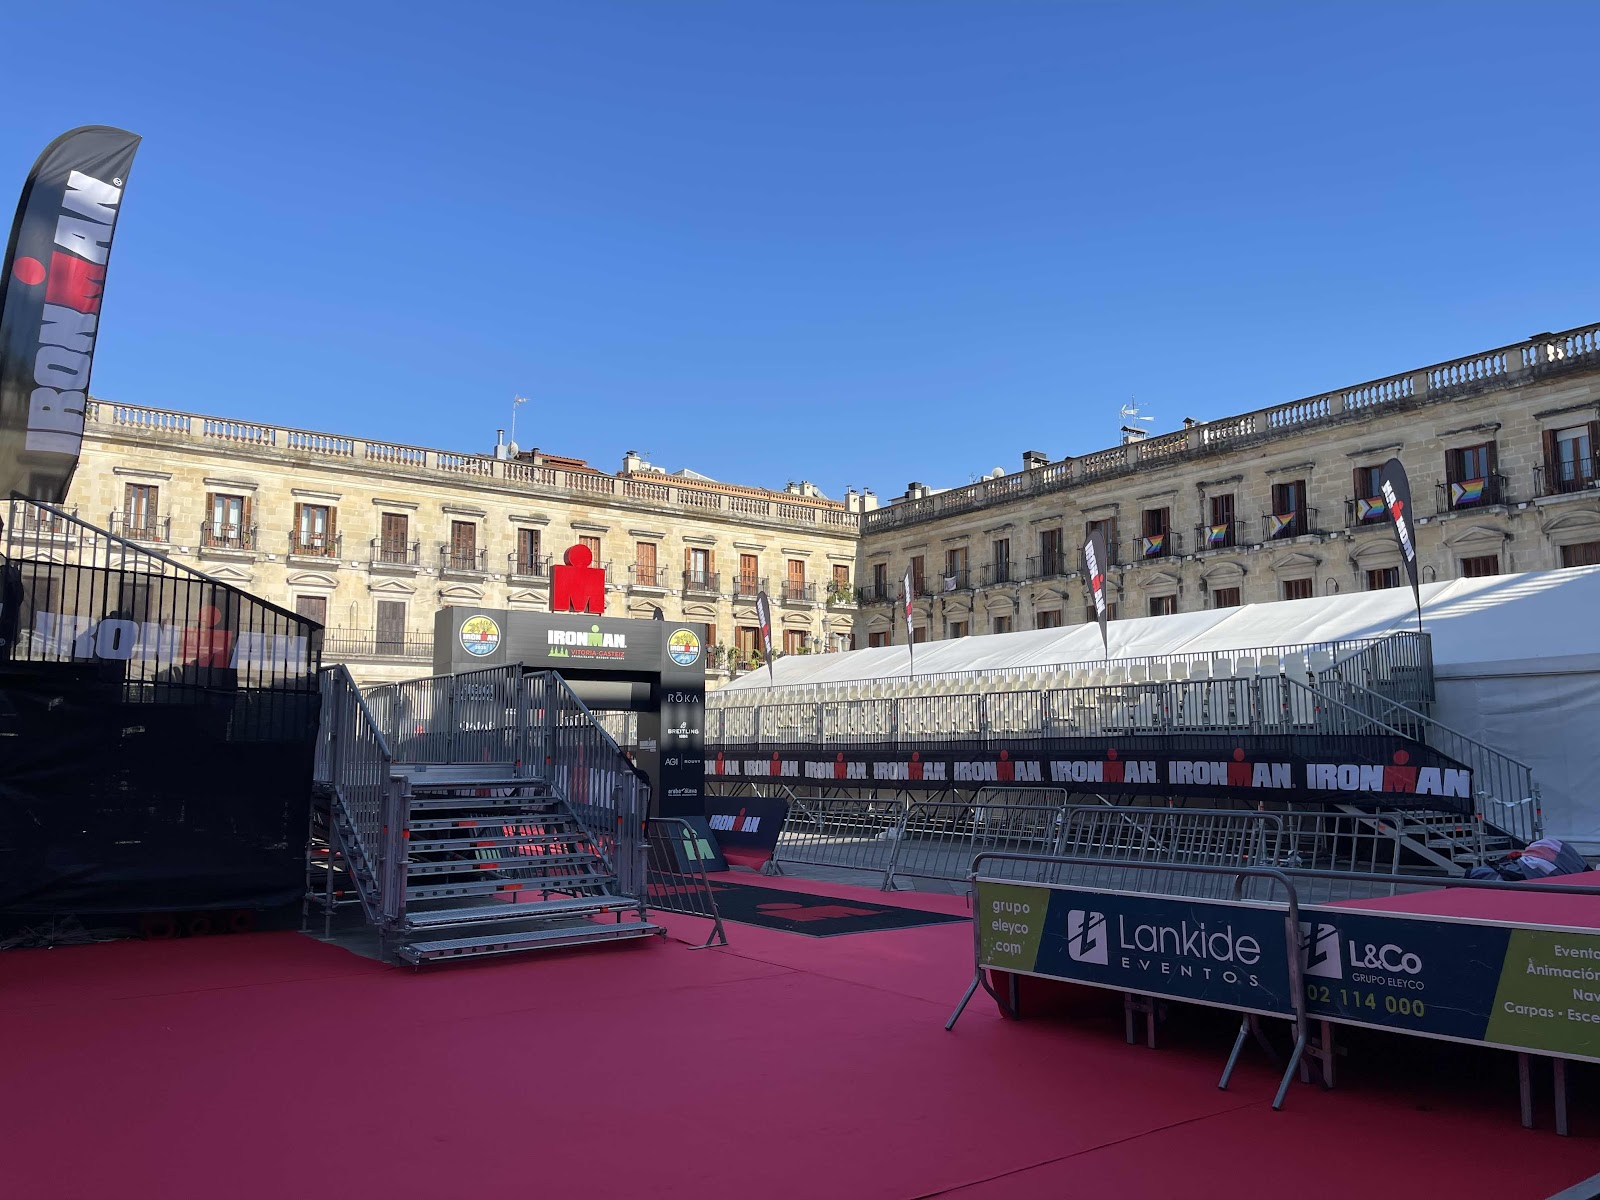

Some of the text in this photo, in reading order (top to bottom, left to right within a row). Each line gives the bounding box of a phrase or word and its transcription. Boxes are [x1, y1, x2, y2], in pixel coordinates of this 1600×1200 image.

[13, 170, 122, 455] IRONMAN
[36, 605, 308, 672] IRONMAN
[548, 624, 626, 648] IRONMAN
[744, 751, 799, 776] IRONMAN
[805, 752, 867, 779] IRONMAN
[873, 751, 946, 780] IRONMAN
[953, 750, 1042, 781] IRONMAN
[1050, 748, 1158, 783] IRONMAN
[1168, 748, 1292, 789] IRONMAN
[1306, 750, 1471, 798] IRONMAN
[709, 807, 761, 833] IRONMAN
[992, 899, 1030, 915] grupo
[991, 918, 1029, 936] eleyco
[1119, 914, 1261, 965] Lankide
[992, 940, 1021, 955] .com
[1348, 940, 1423, 975] L&Co
[1121, 957, 1259, 987] EVENTOS
[1352, 972, 1425, 991] GRUPO ELEYCO
[1307, 984, 1425, 1018] 02 114 000
[1504, 1001, 1555, 1018] Carpas
